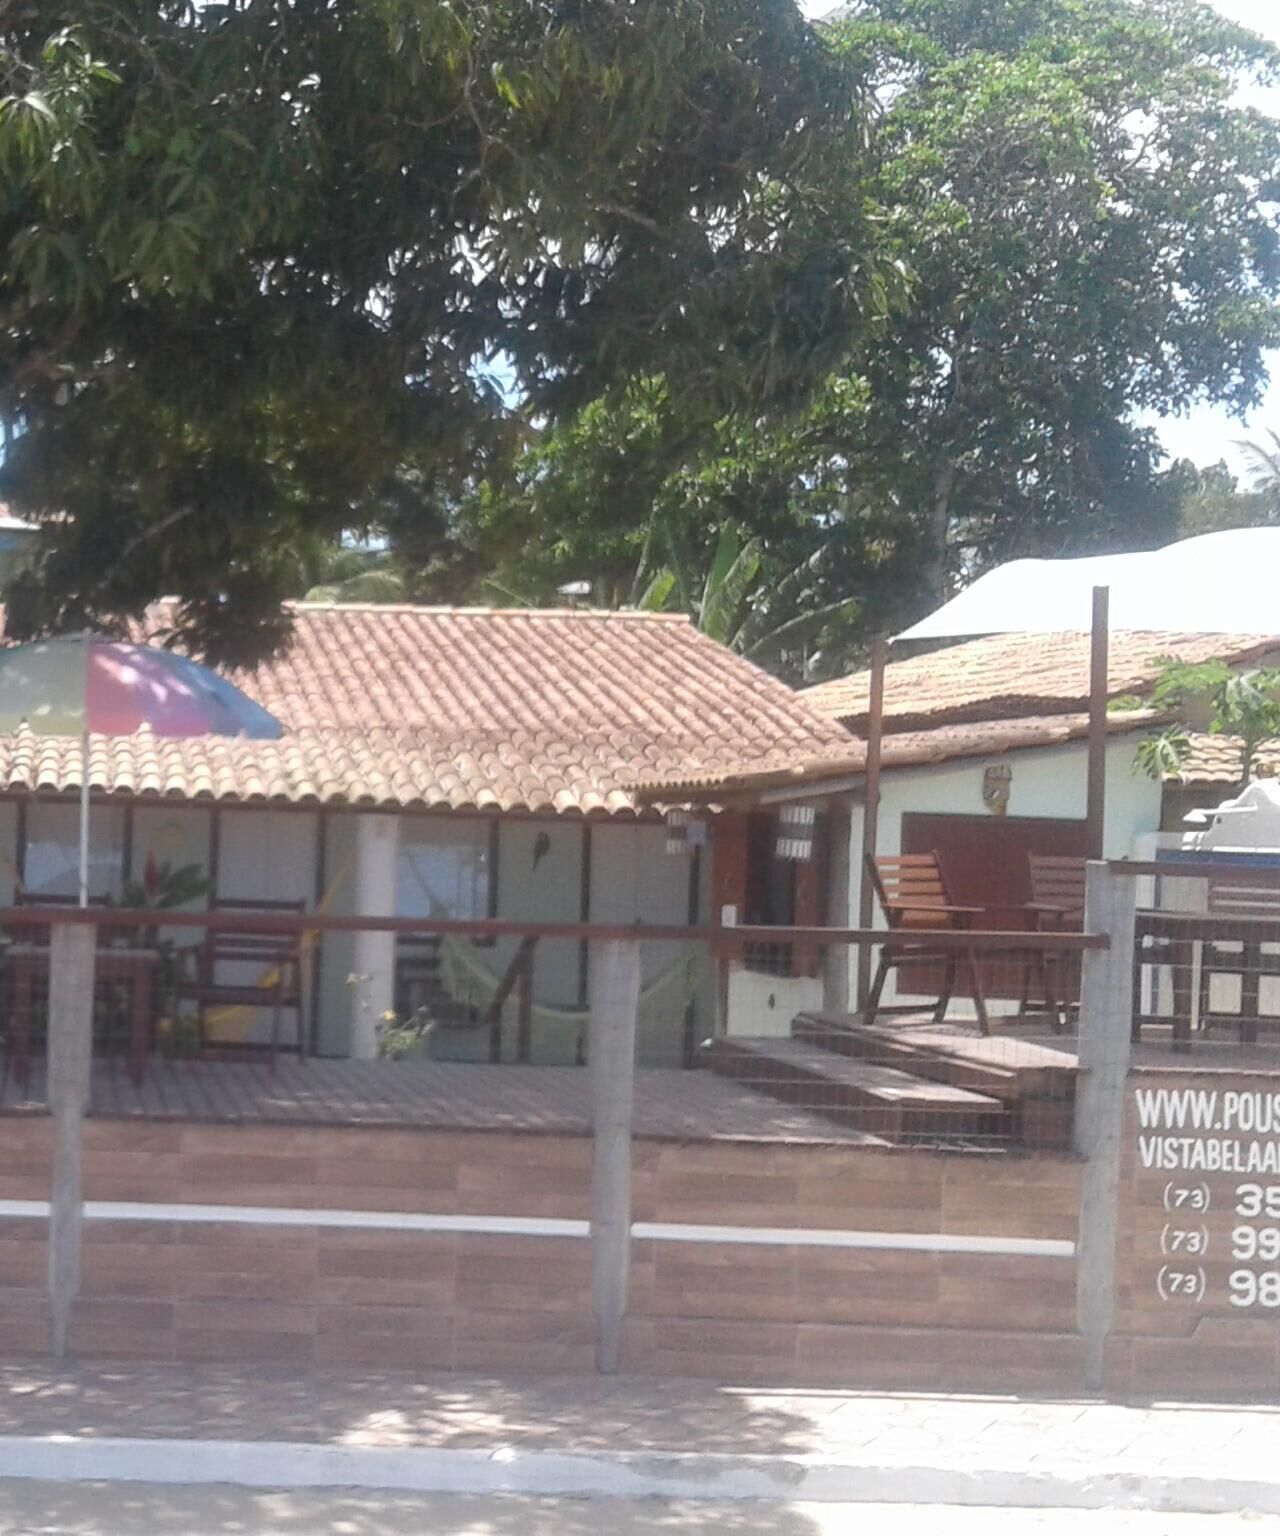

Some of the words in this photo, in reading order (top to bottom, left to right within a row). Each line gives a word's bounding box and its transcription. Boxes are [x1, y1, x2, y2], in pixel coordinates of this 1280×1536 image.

[1138, 1135, 1280, 1173] VISTABELAA
[1163, 1181, 1210, 1214] (73)
[1235, 1183, 1280, 1218] 35
[1160, 1223, 1209, 1256] (73)
[1231, 1225, 1280, 1260] 99
[1157, 1265, 1206, 1302] (73)
[1228, 1269, 1280, 1307] 98
